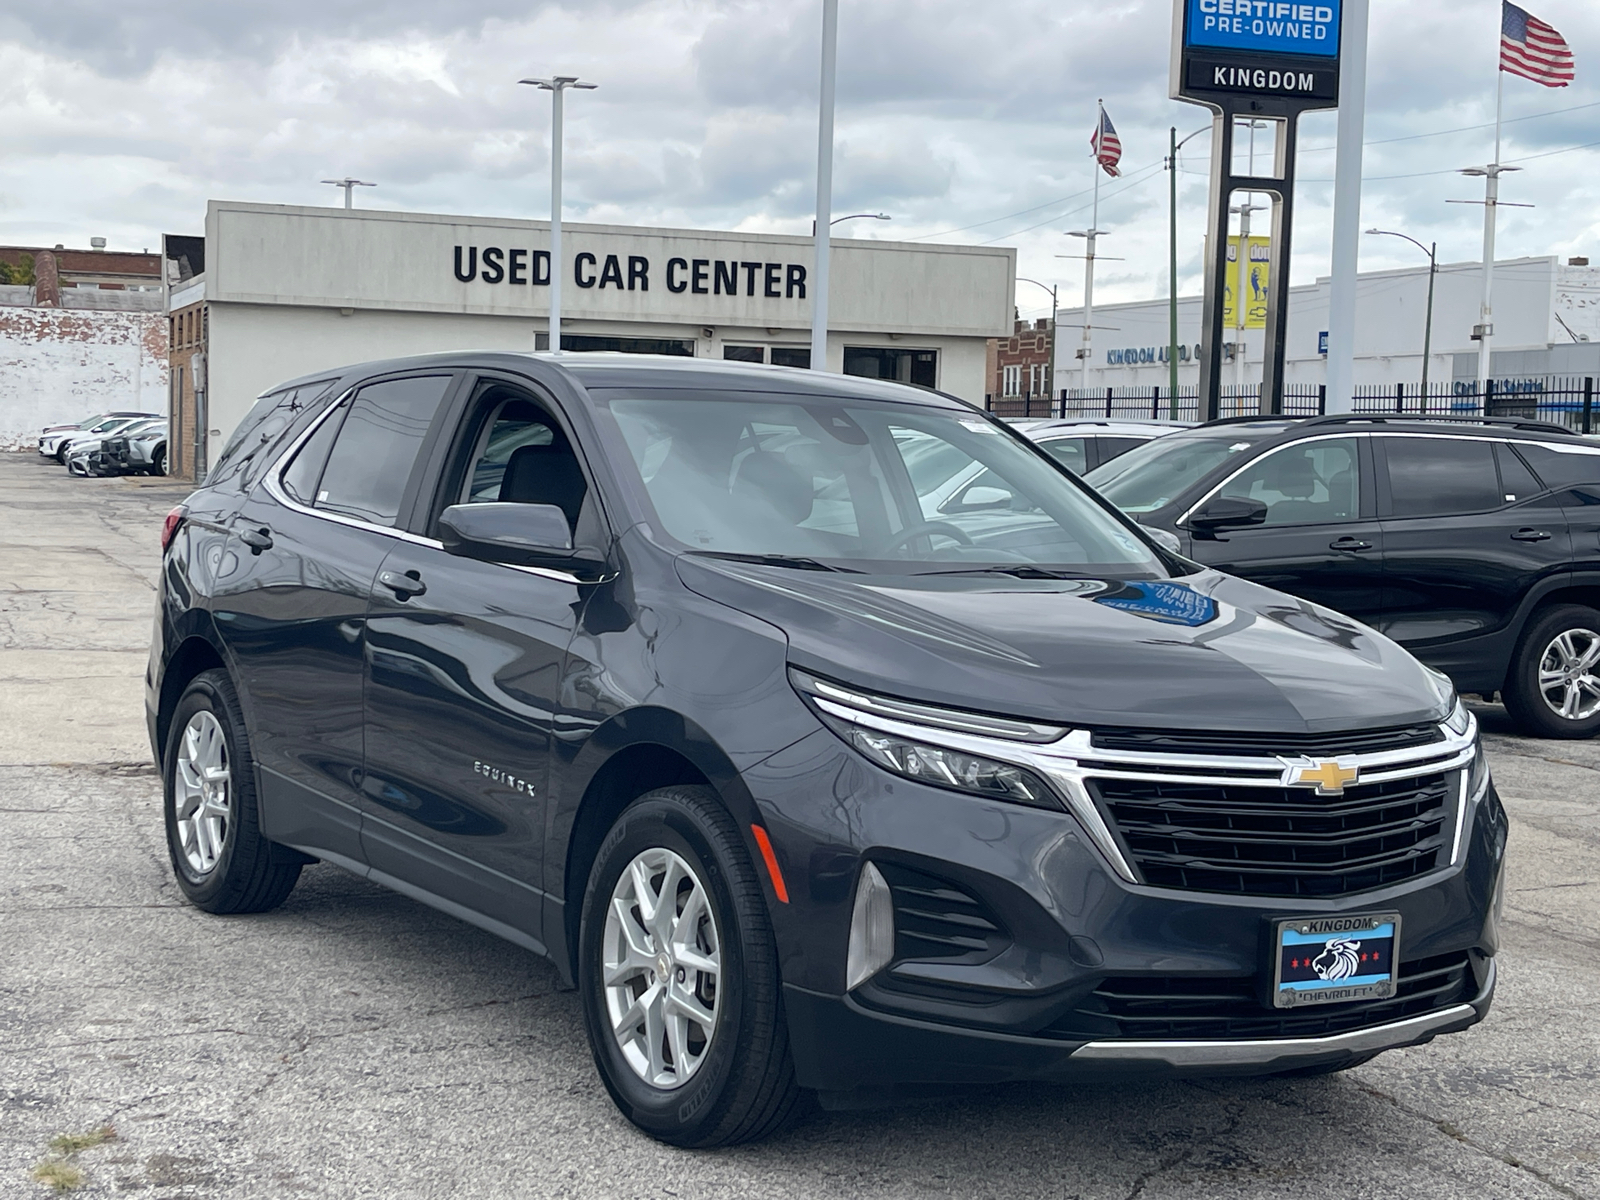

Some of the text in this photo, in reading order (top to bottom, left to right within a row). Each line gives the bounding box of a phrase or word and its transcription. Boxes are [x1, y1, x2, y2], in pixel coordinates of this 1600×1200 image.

[1199, 0, 1333, 23] CERTIFIED
[1204, 15, 1327, 40] PRE-OWNED
[1214, 66, 1314, 92] KINGDOM
[454, 245, 807, 299] USED CAR CENTER
[1107, 347, 1156, 365] KINGDOM
[474, 761, 535, 797] EQUINOX
[1308, 917, 1373, 933] KINGDOM
[1303, 987, 1368, 1002] CHEVROLET
